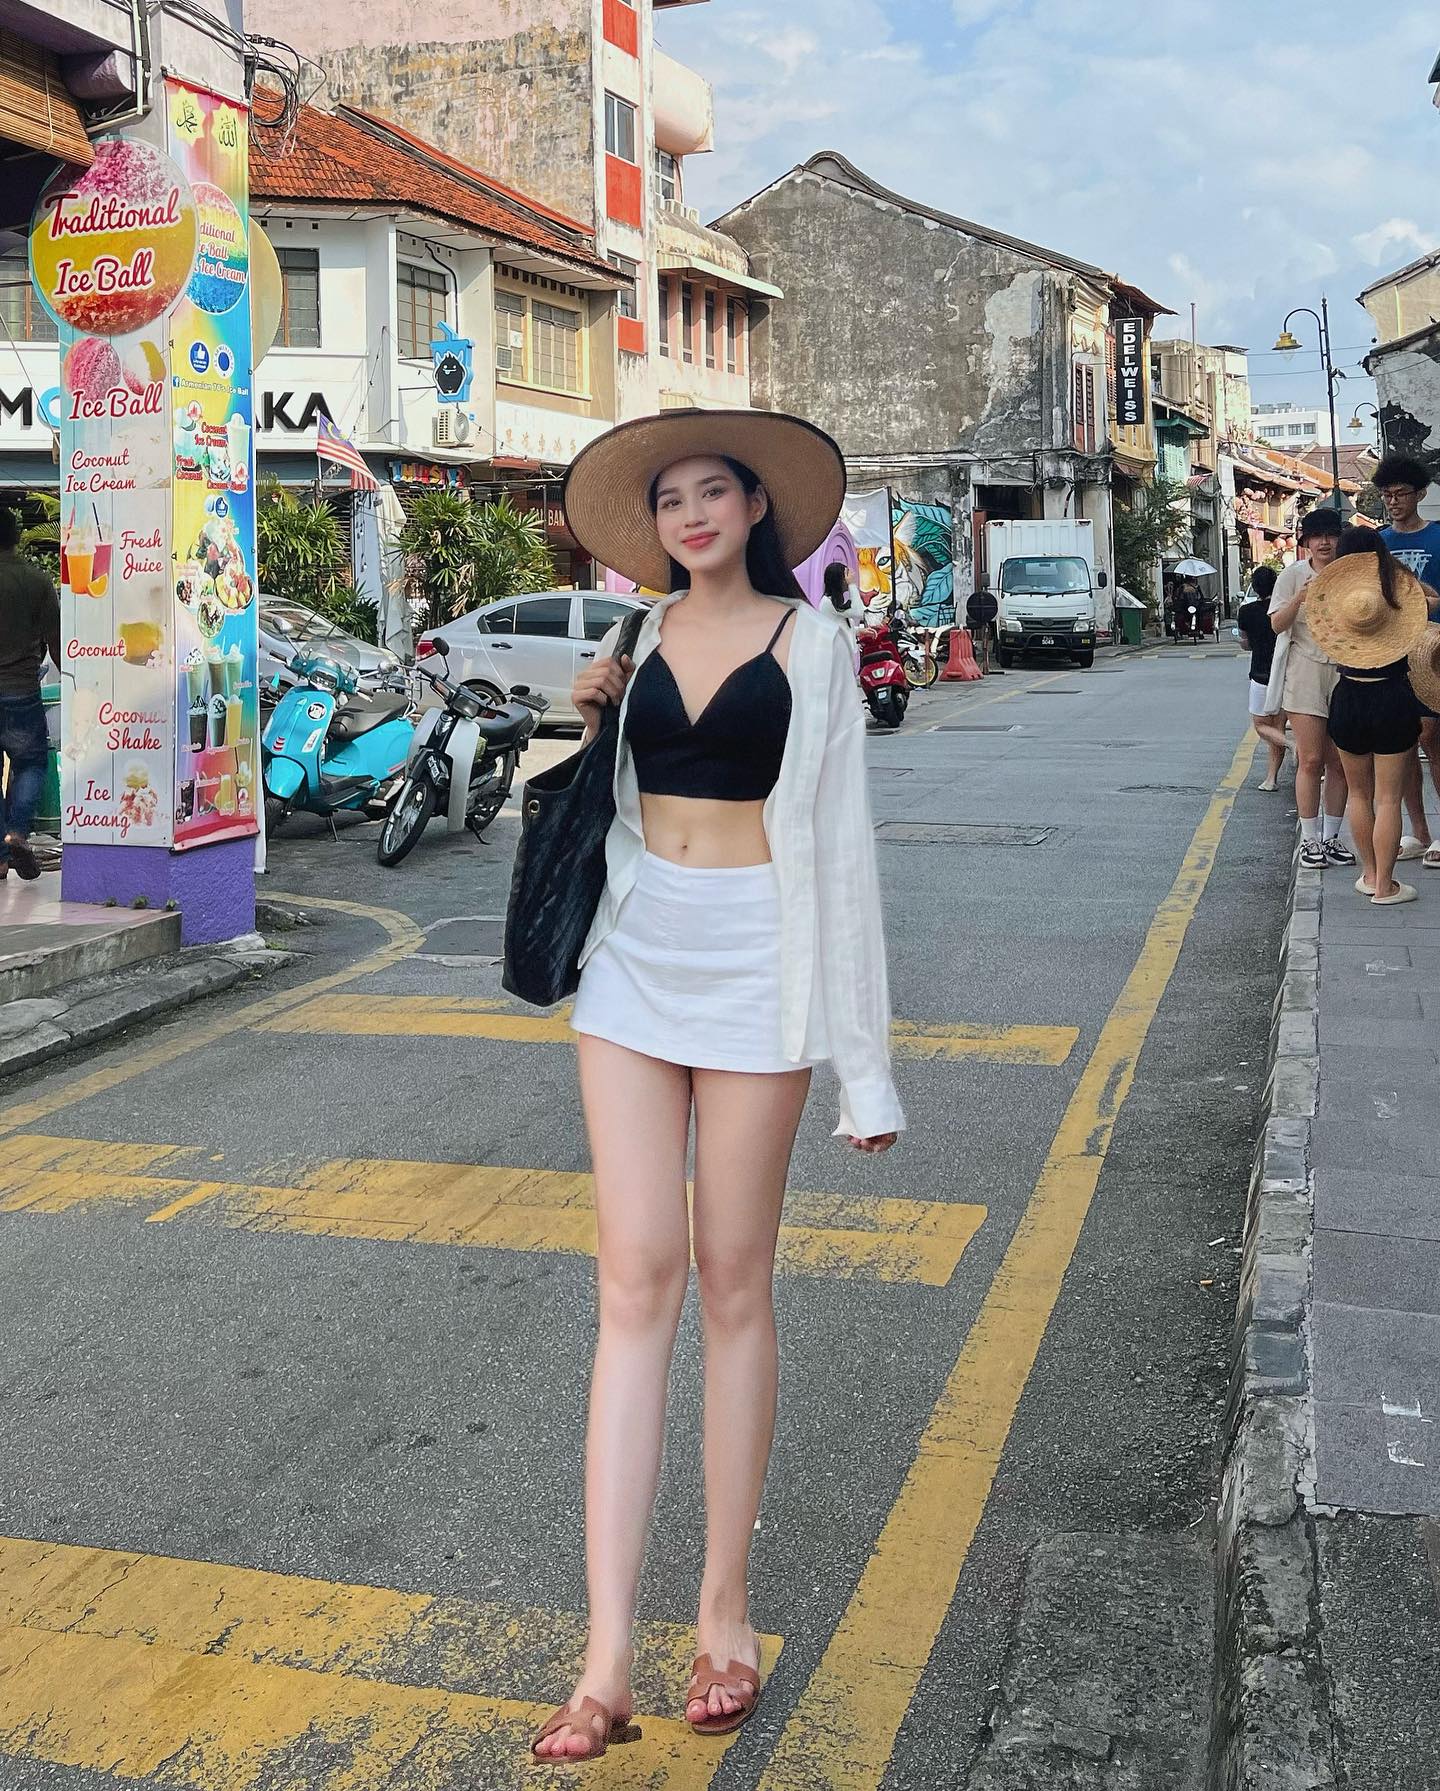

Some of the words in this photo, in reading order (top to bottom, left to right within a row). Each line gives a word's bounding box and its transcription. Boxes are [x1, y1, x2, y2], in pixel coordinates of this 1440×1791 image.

[47, 190, 180, 237] Traditional
[55, 261, 94, 295] Ice
[94, 250, 153, 291] Ball
[216, 262, 246, 283] Cream
[1120, 322, 1139, 422] EDELWEISS
[69, 389, 106, 420] Ice
[107, 381, 164, 416] Ball
[256, 391, 333, 429] KA
[71, 449, 130, 470] Coconut
[64, 475, 87, 493] Ice
[89, 473, 136, 492] Cream
[120, 529, 163, 551] Fresh
[122, 552, 164, 581] Juice
[66, 638, 126, 659] Coconut
[106, 727, 162, 750] Shake
[84, 779, 111, 802] Ice
[65, 805, 131, 838] Kacang
